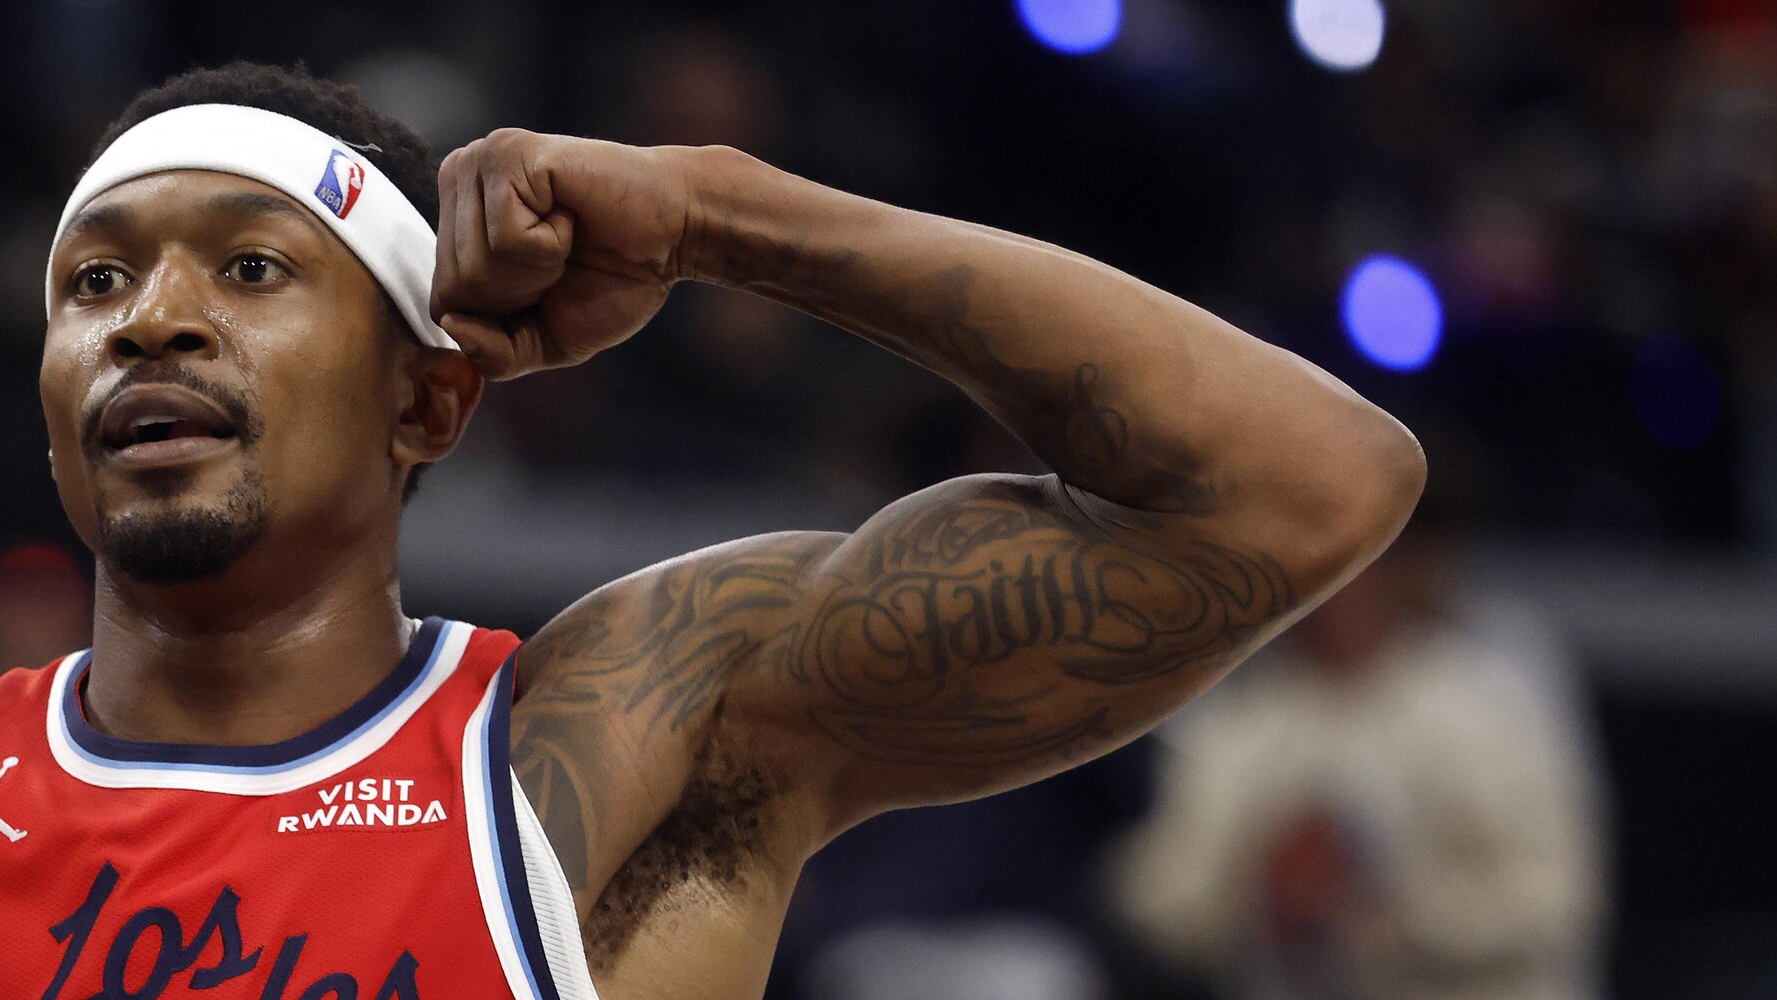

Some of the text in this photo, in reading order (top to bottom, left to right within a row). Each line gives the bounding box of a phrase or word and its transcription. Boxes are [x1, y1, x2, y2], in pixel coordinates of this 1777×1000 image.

[319, 186, 342, 210] NBA
[318, 778, 414, 805] VISIT
[277, 800, 447, 833] RWANDA
